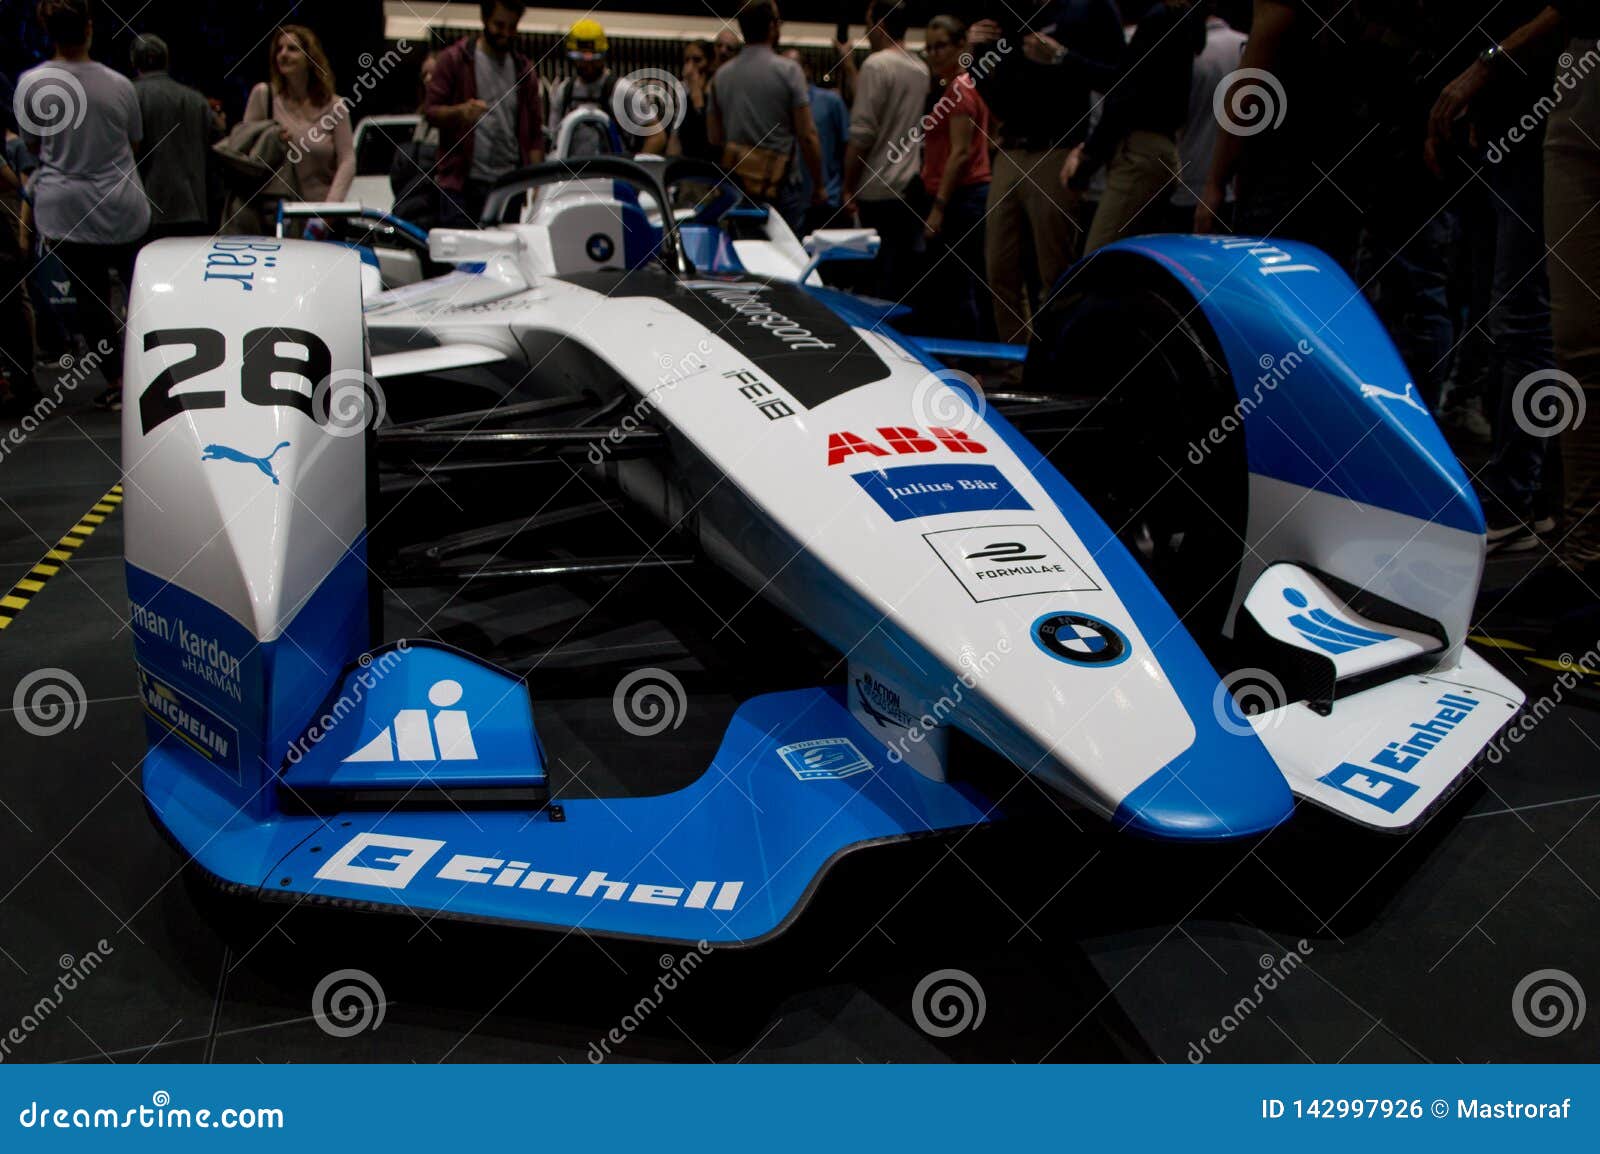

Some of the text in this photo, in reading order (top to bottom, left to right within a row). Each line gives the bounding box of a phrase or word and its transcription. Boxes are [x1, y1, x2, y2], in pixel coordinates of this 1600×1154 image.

[139, 327, 332, 437] 28
[828, 425, 988, 466] ABB
[885, 479, 999, 500] Julius Bär
[147, 688, 229, 758] MICHELIN
[1370, 693, 1480, 774] Einhell
[436, 854, 744, 911] Einhell
